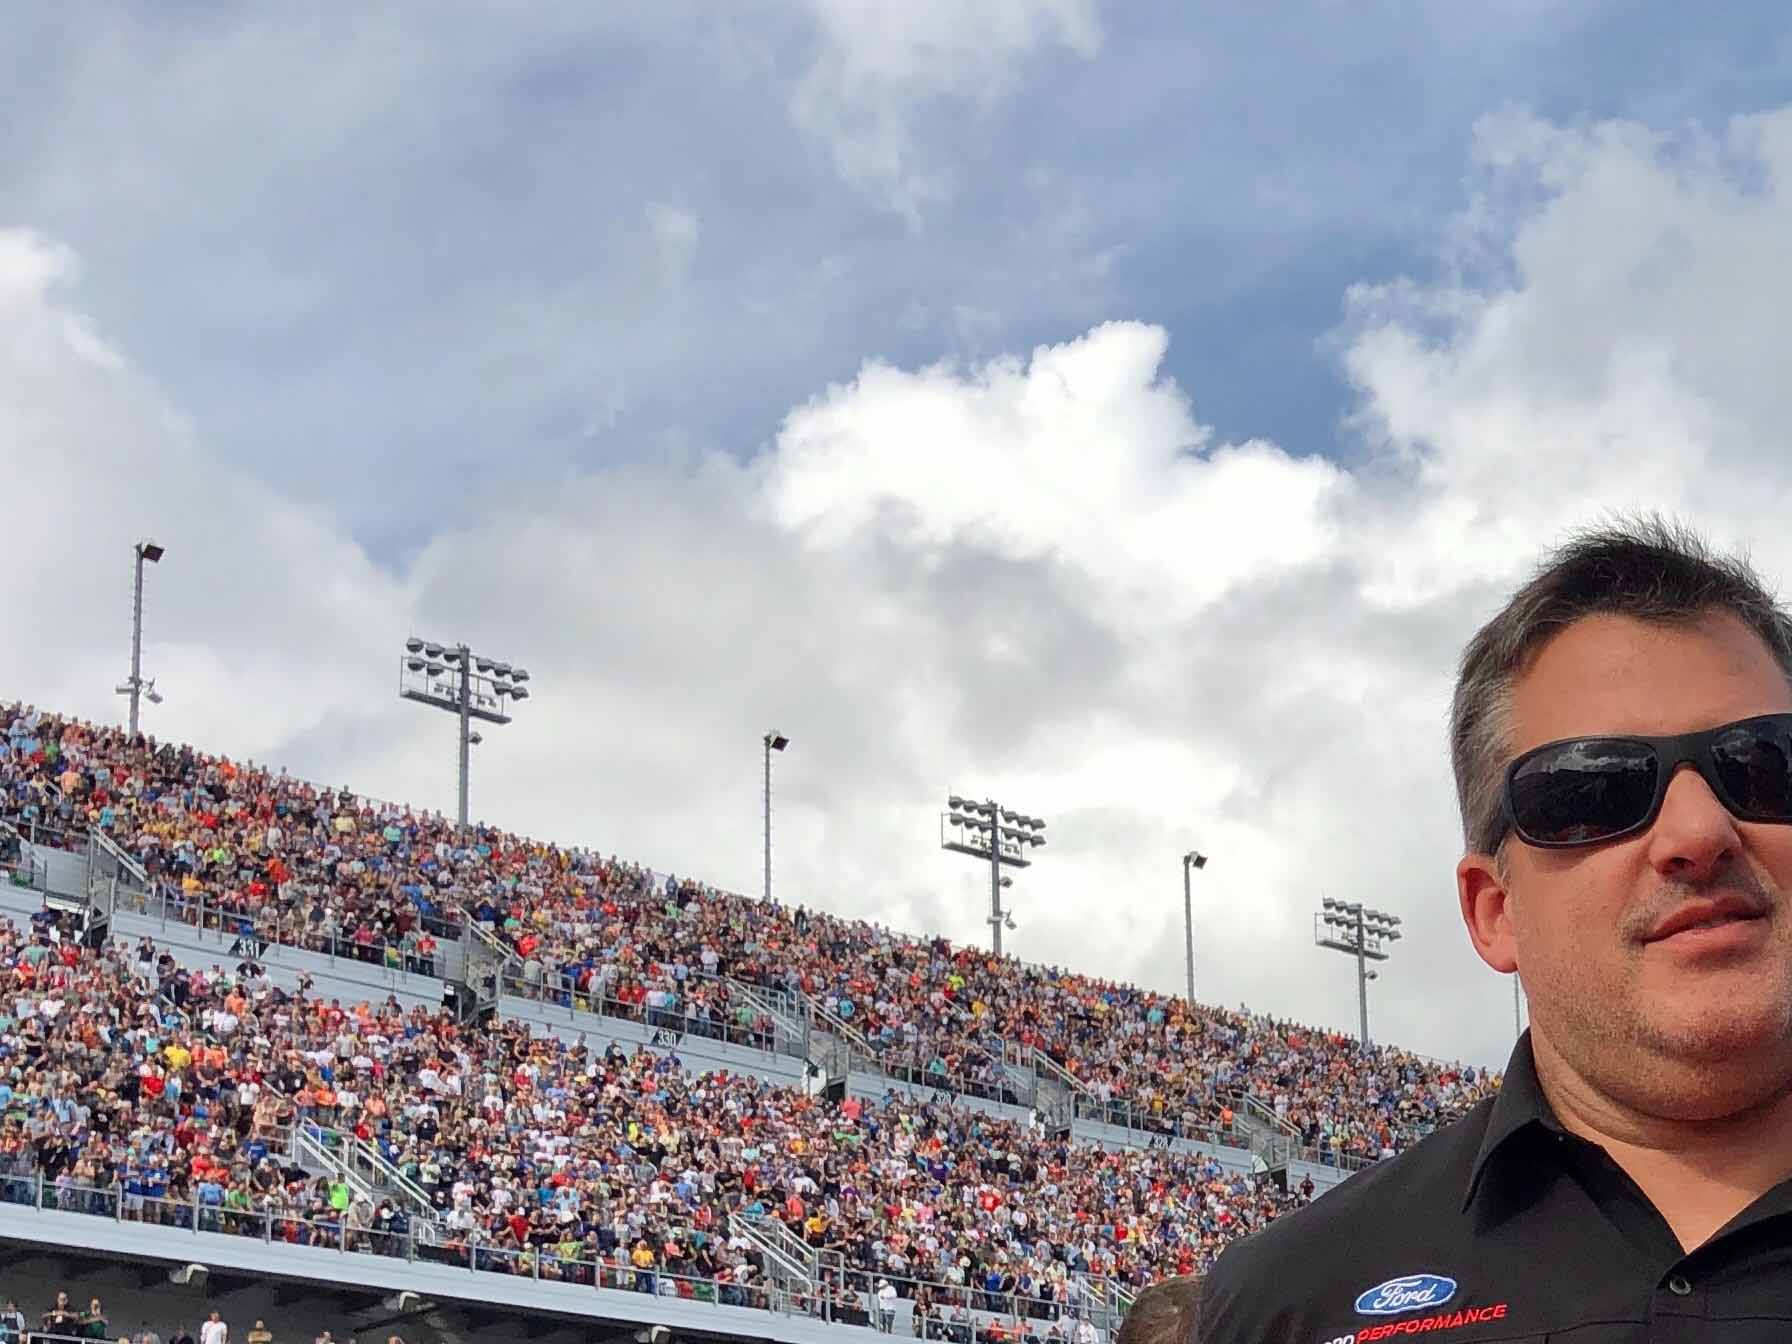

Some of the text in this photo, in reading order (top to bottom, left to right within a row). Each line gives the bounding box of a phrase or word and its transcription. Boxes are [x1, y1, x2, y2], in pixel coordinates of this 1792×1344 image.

[239, 939, 260, 959] 331
[657, 1030, 677, 1047] 330
[1373, 1280, 1437, 1310] Ford
